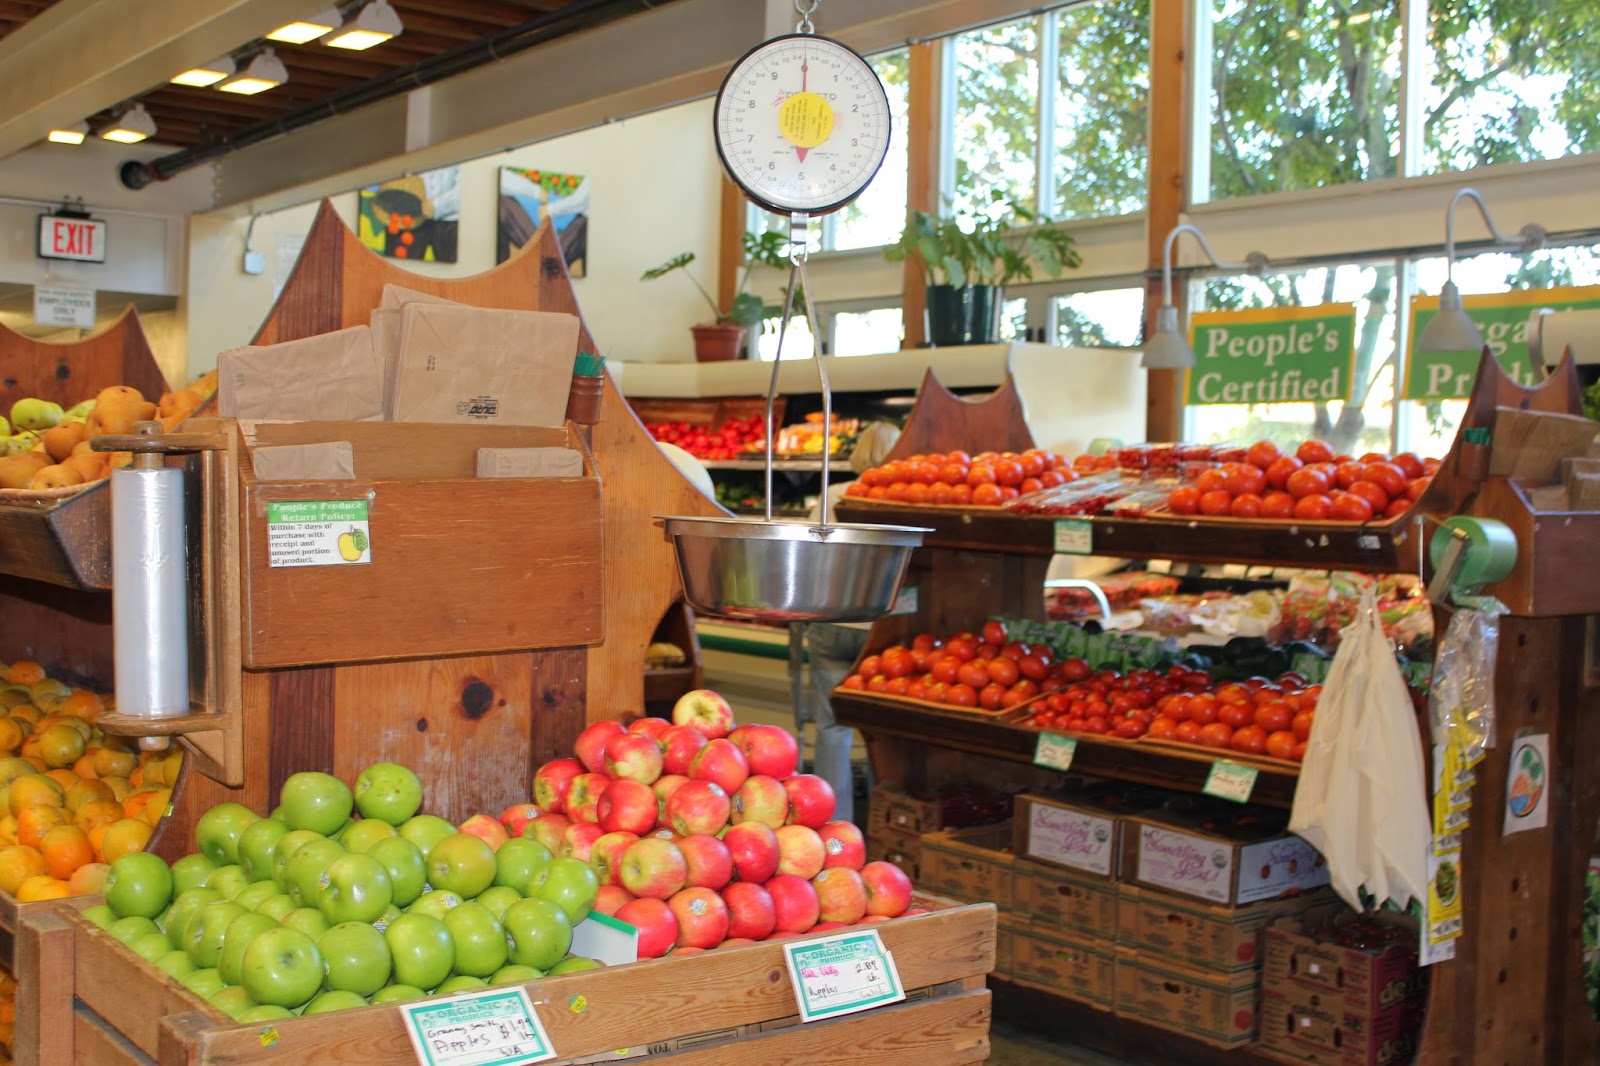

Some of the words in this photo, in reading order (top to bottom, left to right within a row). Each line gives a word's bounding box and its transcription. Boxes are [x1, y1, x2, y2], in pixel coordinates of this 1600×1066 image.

[771, 72, 778, 80] 9
[749, 100, 756, 108] 8
[852, 104, 858, 112] 2
[852, 138, 858, 147] 3
[769, 161, 775, 170] 6
[798, 172, 805, 180] 5
[54, 222, 96, 256] EXIT
[1206, 321, 1339, 366] People's
[1198, 367, 1340, 402] Certified
[274, 503, 317, 512] People's
[320, 502, 362, 510] Produce
[810, 944, 862, 960] ORGANIC
[820, 953, 854, 963] PRODUCE
[808, 984, 838, 998] Apples
[436, 1001, 502, 1019] ORGANIC
[449, 1011, 494, 1023] PRODUCE
[428, 1028, 468, 1038] Granny
[433, 1033, 490, 1053] Apples
